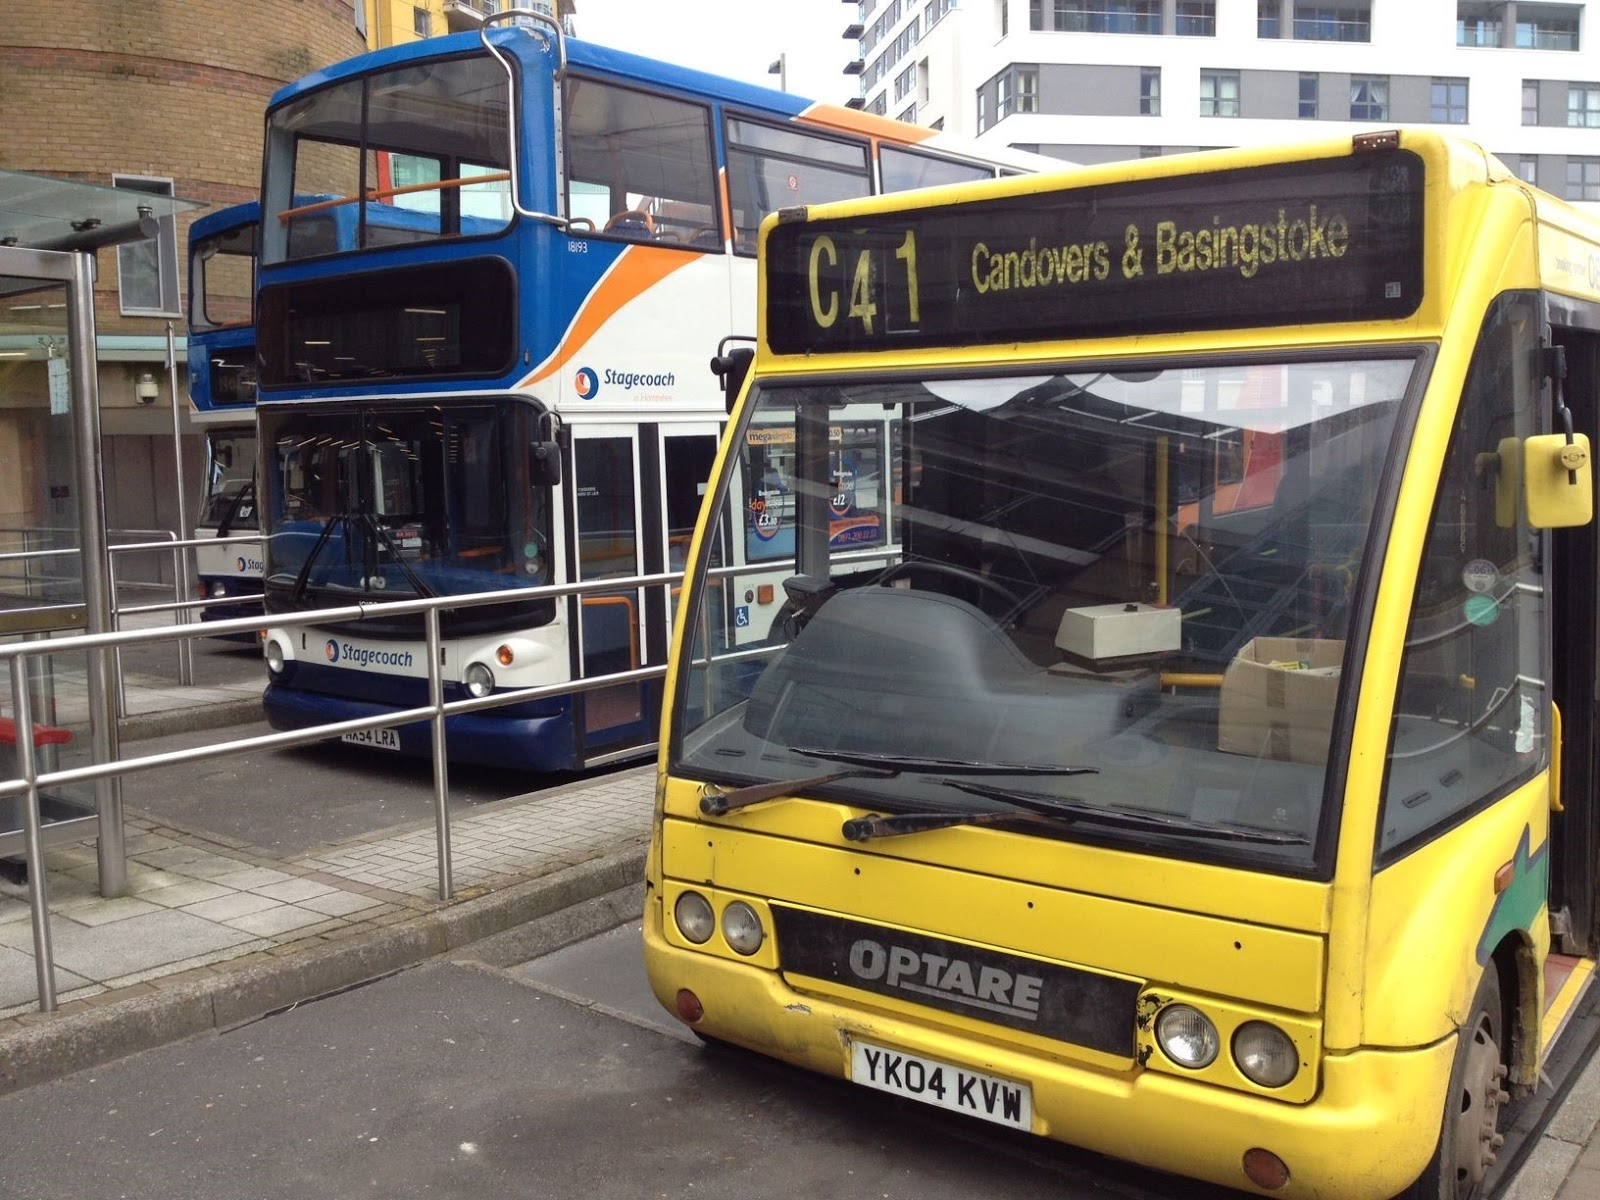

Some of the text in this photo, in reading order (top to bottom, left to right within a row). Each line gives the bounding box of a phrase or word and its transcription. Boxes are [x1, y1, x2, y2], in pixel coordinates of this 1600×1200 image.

[567, 240, 588, 253] 18193
[971, 236, 1110, 294] Candovers
[1121, 223, 1144, 280] &
[1156, 204, 1350, 279] Basingstoke
[604, 368, 676, 390] Stagecoach
[342, 643, 413, 667] Stagecoach
[374, 728, 396, 747] LRA
[849, 939, 1044, 1012] OPTARE
[863, 1047, 1022, 1123] YK04 KVW
